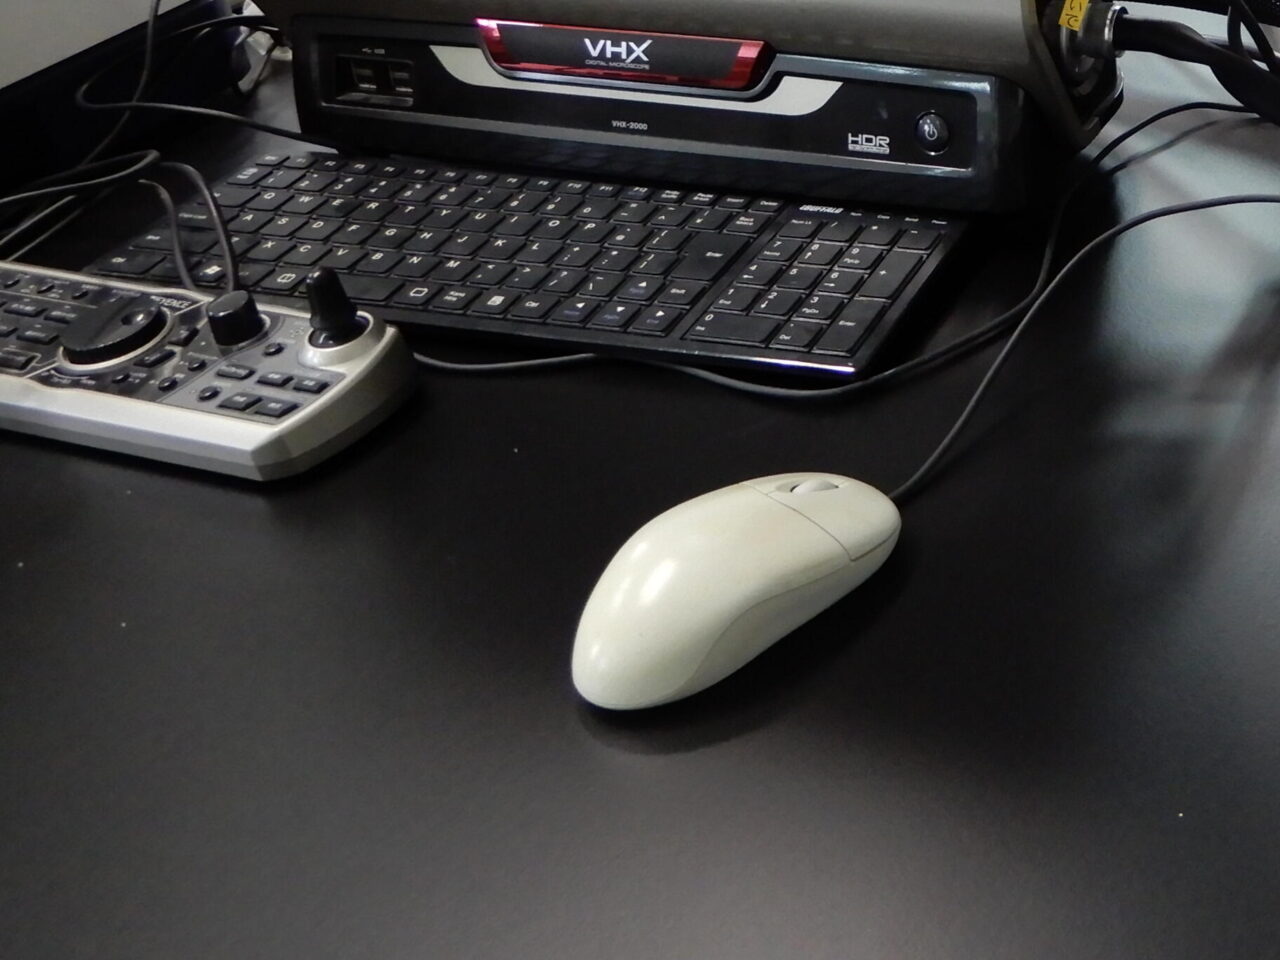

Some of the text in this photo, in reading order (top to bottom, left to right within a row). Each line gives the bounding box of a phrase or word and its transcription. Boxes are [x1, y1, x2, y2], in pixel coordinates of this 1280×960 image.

[584, 38, 653, 63] VHX
[611, 120, 648, 130] VHX-2000
[848, 132, 890, 148] HDR
